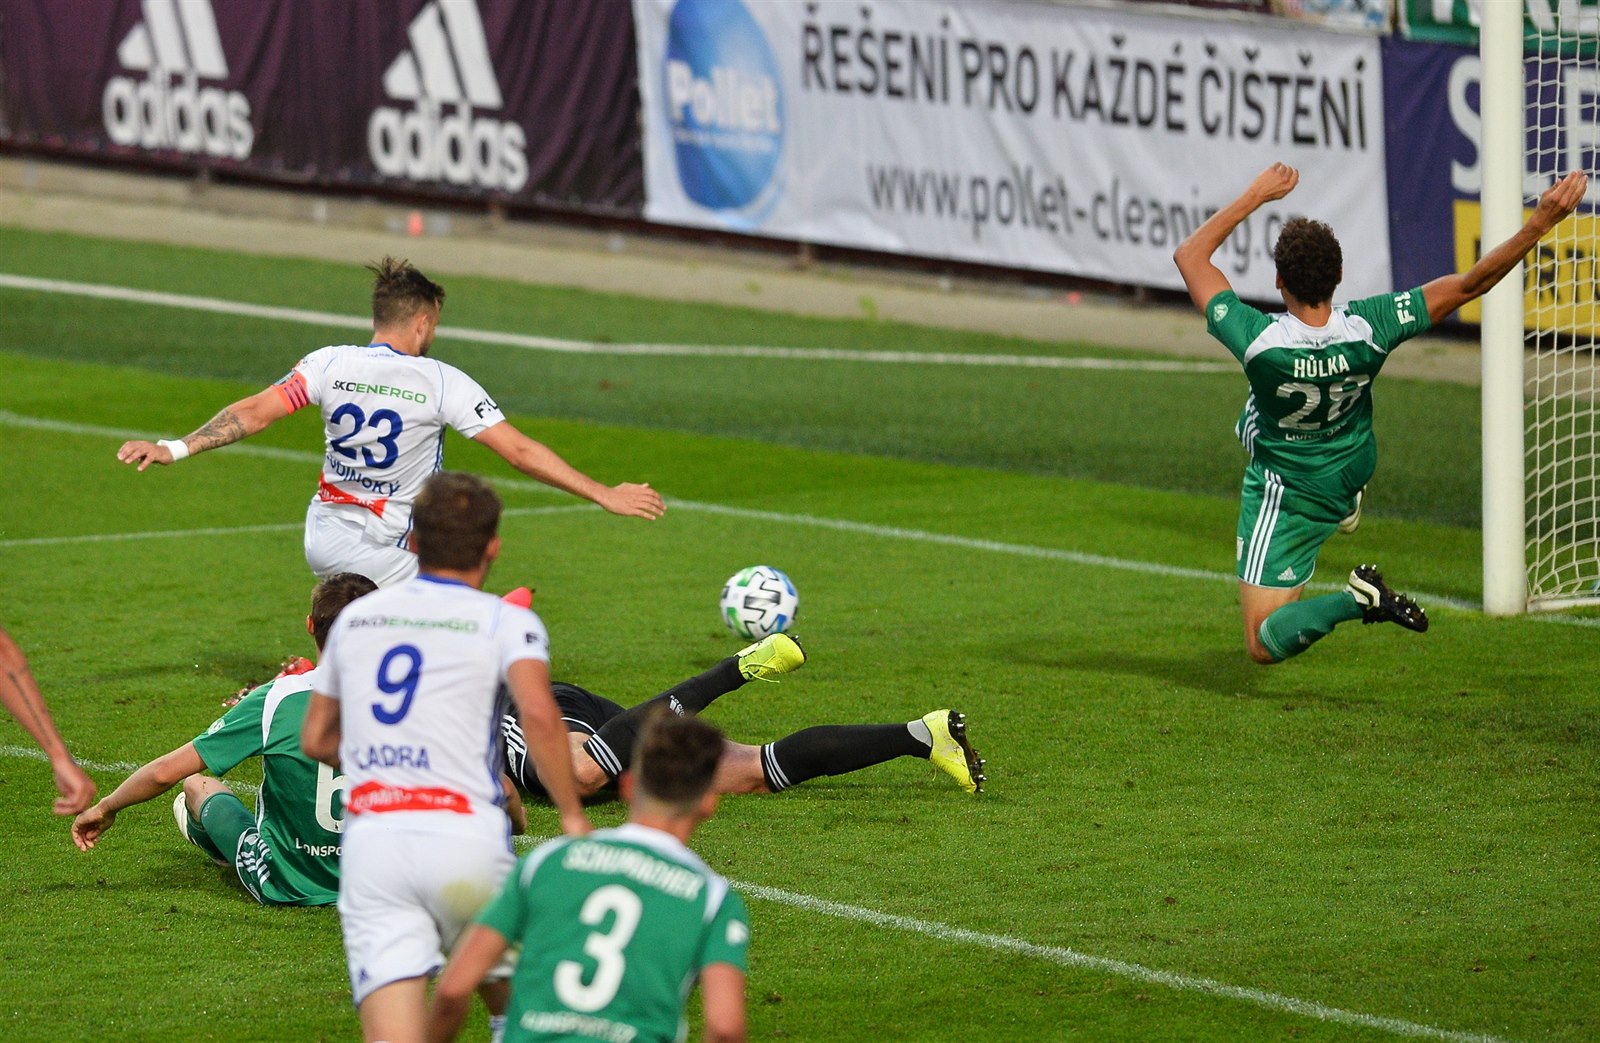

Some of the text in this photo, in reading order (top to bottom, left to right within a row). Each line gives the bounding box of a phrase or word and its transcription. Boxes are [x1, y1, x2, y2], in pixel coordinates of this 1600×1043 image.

[103, 71, 254, 160] adidas
[666, 60, 780, 134] Pollet
[801, 2, 1367, 151] ŘEŠENÍ PRO KAŽDÉ ČIŠTĚNÍ
[368, 98, 530, 192] adidas
[1277, 375, 1370, 430] 28
[1293, 354, 1351, 379] HŮLKA
[329, 402, 404, 469] 23
[371, 644, 423, 725] 9
[553, 883, 644, 1014] 3
